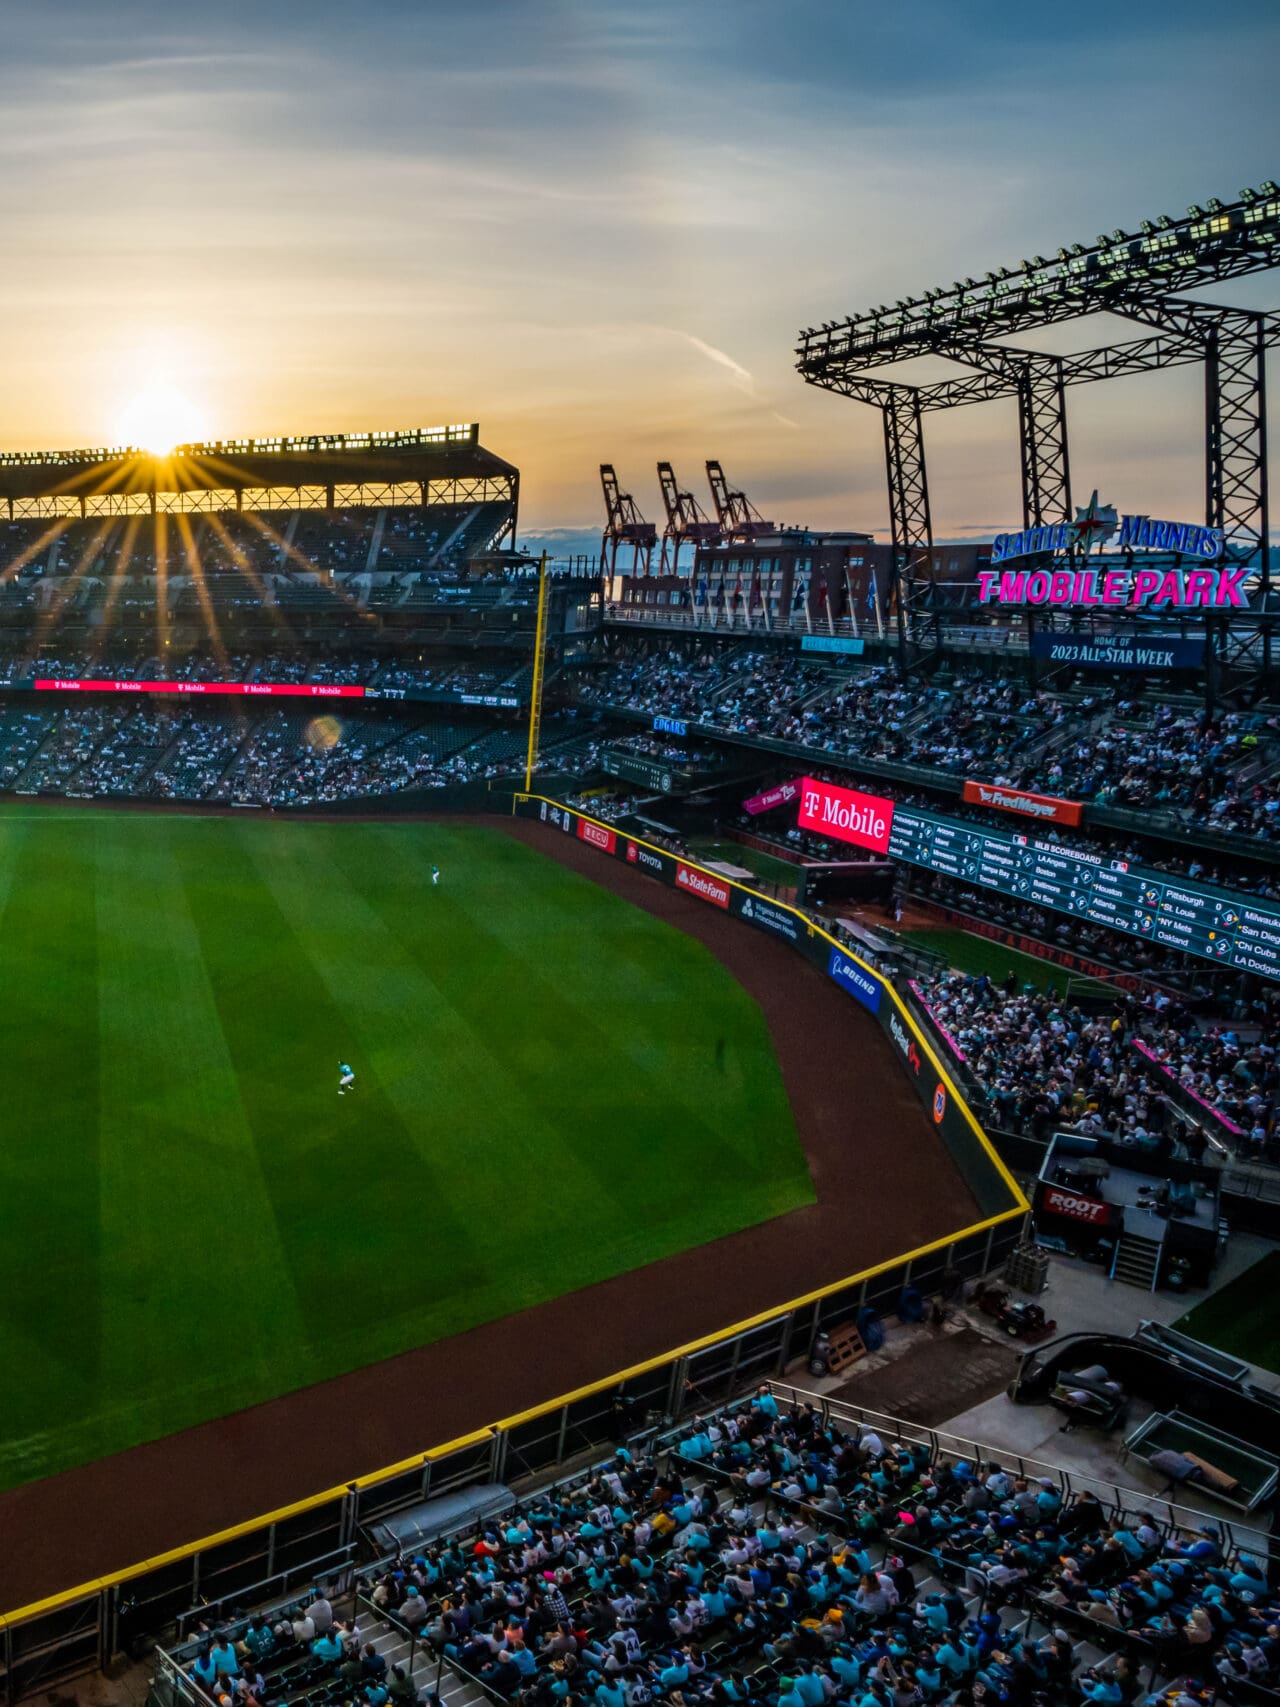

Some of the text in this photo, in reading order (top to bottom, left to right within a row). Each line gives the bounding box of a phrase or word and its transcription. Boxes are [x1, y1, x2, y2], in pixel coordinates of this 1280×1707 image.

[991, 515, 1222, 563] SEATTLE MARINERS
[977, 567, 1256, 608] T-MOBILE PARK
[1094, 636, 1130, 646] HOME OF
[1050, 645, 1078, 660] 2023
[1136, 648, 1175, 667] WEEK
[822, 796, 885, 838] Mobile
[585, 826, 608, 843] BECU
[638, 851, 663, 870] TOYOTA
[1034, 841, 1102, 864] MLB SCOREBOARD
[1165, 889, 1205, 907] Pittsburgh
[1134, 909, 1142, 917] 10
[1175, 906, 1196, 919] Louis
[1173, 921, 1192, 933] Mets
[1241, 925, 1259, 937] San
[1157, 931, 1189, 946] Oakland
[1019, 938, 1055, 960] BEST
[1058, 949, 1075, 968] IN
[1079, 959, 1109, 978] THE
[1237, 941, 1277, 959] Chi Cubs
[1234, 954, 1247, 966] LA
[842, 965, 876, 995] BOEING
[1049, 1192, 1104, 1216] ROOT
